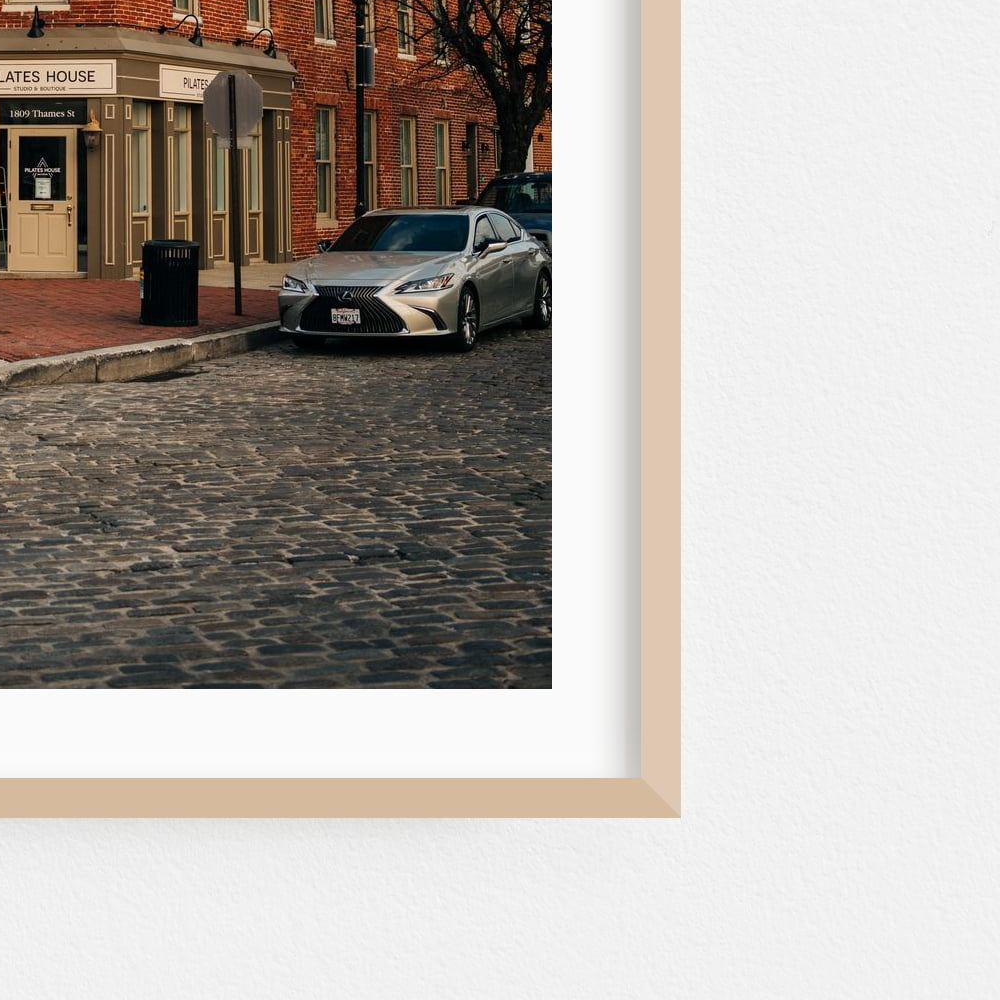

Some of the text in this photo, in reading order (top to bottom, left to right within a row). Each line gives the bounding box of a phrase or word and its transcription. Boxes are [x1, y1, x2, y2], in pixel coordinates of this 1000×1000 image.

[46, 70, 96, 83] HOUSE
[183, 77, 209, 90] PILATES
[9, 109, 75, 118] 1809 Thames St
